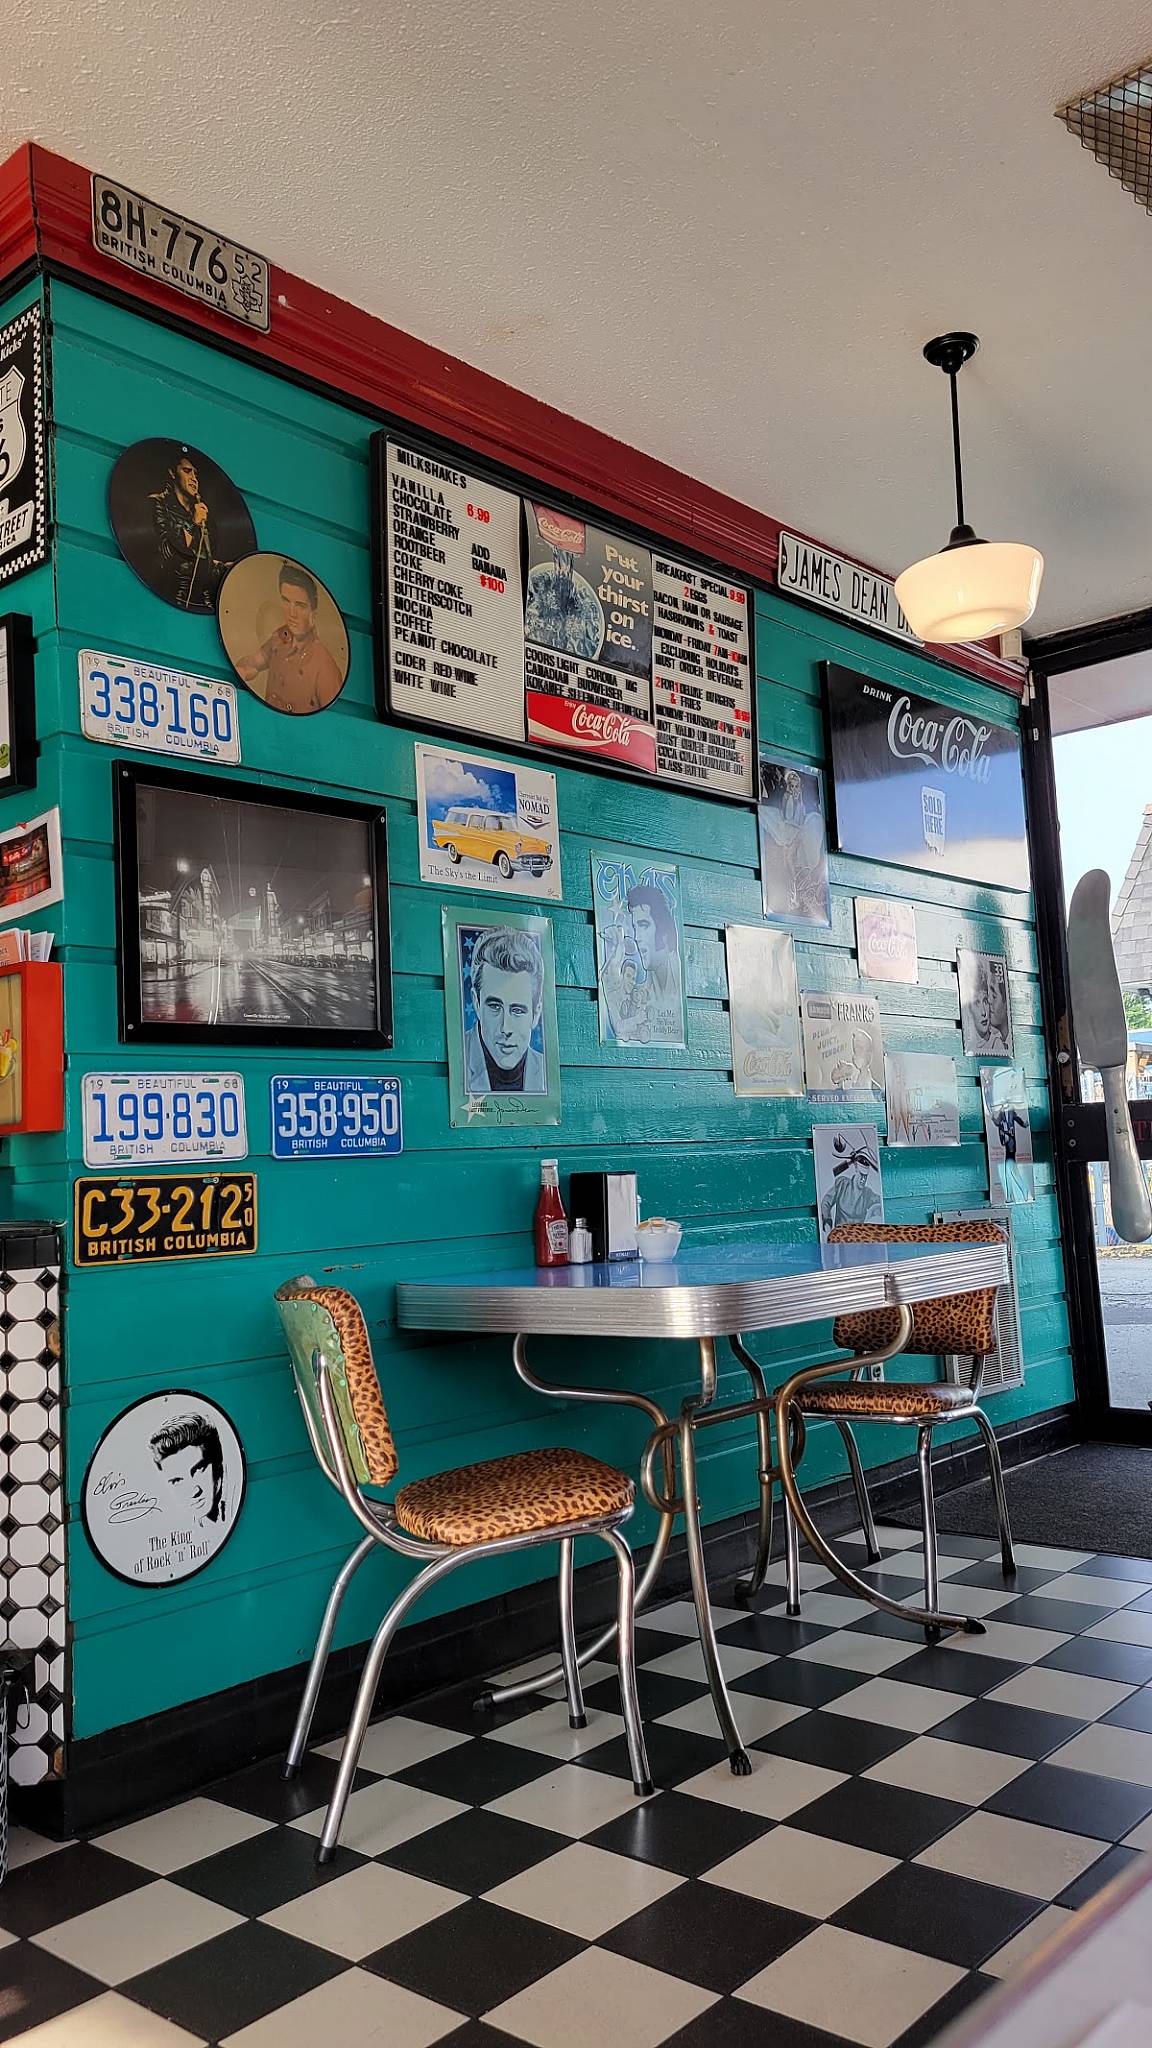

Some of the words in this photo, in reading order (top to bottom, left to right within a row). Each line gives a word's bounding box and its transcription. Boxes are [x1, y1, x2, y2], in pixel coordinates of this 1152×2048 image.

[100, 190, 228, 285] 8H-776
[234, 253, 262, 284] 52
[101, 233, 155, 268] BRITISH
[162, 261, 227, 305] COLUMBIA
[397, 448, 467, 489] MILKSHAKES
[392, 473, 445, 506] VANILLA
[392, 488, 452, 523] CHOCOLATE
[393, 503, 460, 541] STRAWBERRY
[393, 519, 436, 546] ORANGE
[393, 533, 446, 565] ROOTBEER
[393, 549, 423, 572] COKE
[471, 543, 490, 560] ADD
[605, 544, 639, 572] Put
[393, 565, 435, 590] CHERRY
[437, 578, 464, 600] COKE
[471, 557, 508, 581] BANANA
[601, 565, 645, 591] your
[656, 561, 697, 586] BREAKFAST
[701, 578, 729, 598] SPECIAL
[683, 587, 689, 598] 2
[690, 589, 708, 604] EGGS
[789, 544, 842, 602] JAMES
[851, 572, 889, 624] DEAN
[394, 580, 473, 617] BUTTERSCOTCH
[394, 595, 433, 620] MOCHA
[597, 584, 649, 617] thirst
[394, 611, 433, 634] COFFEE
[610, 611, 635, 630] on
[682, 600, 699, 615] HAM
[701, 607, 711, 620] OR
[713, 612, 744, 632] SAUSAGE
[395, 626, 437, 651] PEANUT
[441, 640, 498, 669] CHOCOLATE
[133, 666, 191, 689] BEAUTIFUL
[395, 651, 426, 671] CIDER
[433, 661, 452, 679] RED
[455, 667, 479, 687] WINE
[525, 646, 555, 668] COORS
[557, 657, 580, 675] LIGHT
[586, 666, 618, 687] CORONA
[680, 660, 704, 678] ORDER
[430, 678, 457, 699] WINE
[525, 661, 569, 685] CANADIAN
[577, 677, 623, 701] BUDWEISER
[863, 685, 892, 703] DRINK
[107, 722, 150, 739] BRITISH
[165, 734, 220, 753] COLUMBIA
[571, 704, 631, 746] Coca-Cola
[887, 696, 992, 784] Coca-Cola
[518, 798, 550, 815] NOMAD
[923, 794, 943, 816] SOLD
[924, 814, 943, 836] HERE
[428, 864, 444, 876] The
[465, 870, 477, 881] the
[478, 872, 498, 884] Limit
[837, 1003, 875, 1023] FRANKS
[89, 1079, 103, 1090] 19
[137, 1078, 198, 1090] BEAUTIFUL
[223, 1078, 240, 1089] 68
[276, 1080, 289, 1090] 19
[313, 1080, 364, 1092] BEAUTIFUL
[384, 1080, 398, 1091] 69
[109, 1143, 154, 1156] BRITISH
[170, 1140, 226, 1153] COLUMBIA
[291, 1138, 328, 1150] BRITISH
[340, 1136, 387, 1148] COLUMBIA
[87, 1234, 157, 1257] BRITISH
[163, 1230, 247, 1250] COLUMBIA
[149, 1536, 167, 1552] The
[171, 1530, 193, 1546] King
[133, 1558, 145, 1575] of
[147, 1551, 171, 1572] Rock
[190, 1541, 209, 1559] Roll
